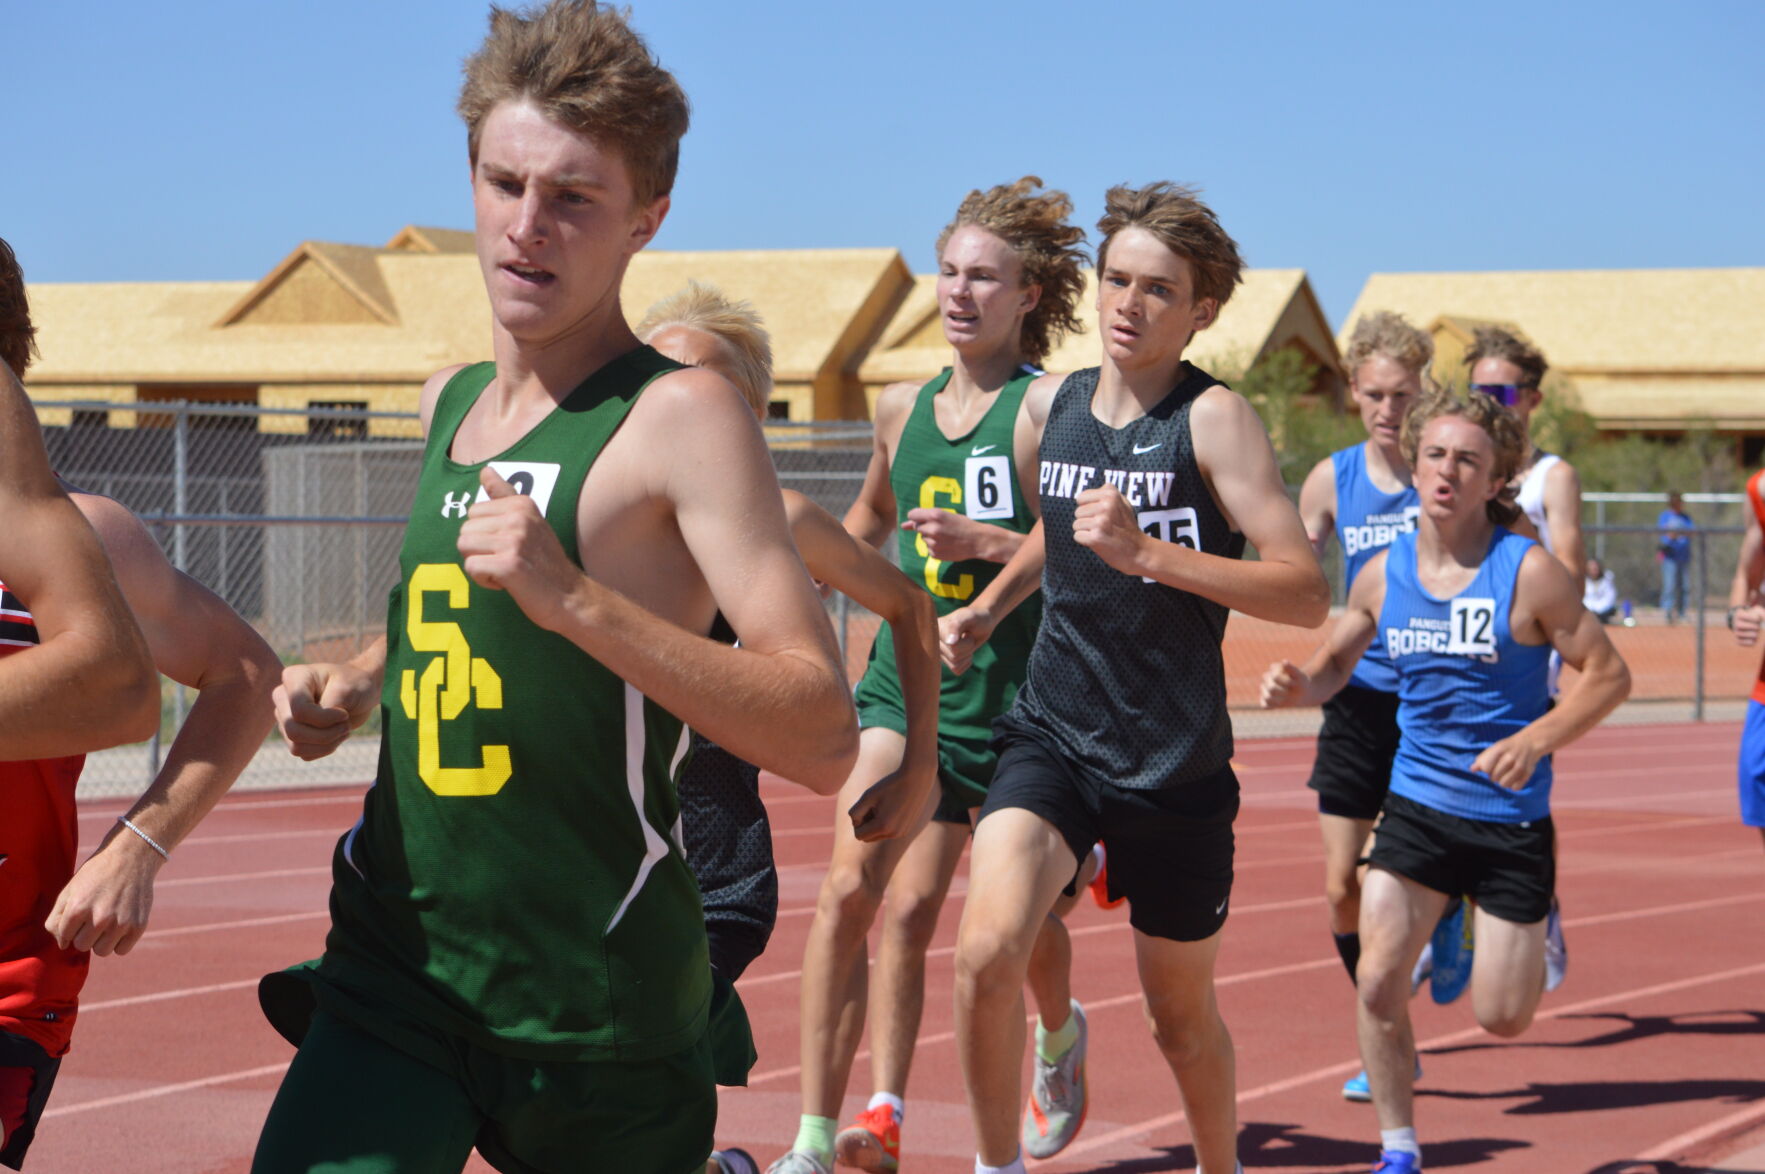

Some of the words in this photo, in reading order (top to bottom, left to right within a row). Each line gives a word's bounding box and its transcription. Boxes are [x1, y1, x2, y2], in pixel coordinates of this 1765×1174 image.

[977, 466, 999, 508] 6
[1039, 461, 1096, 499] PINE
[1457, 607, 1492, 644] 12
